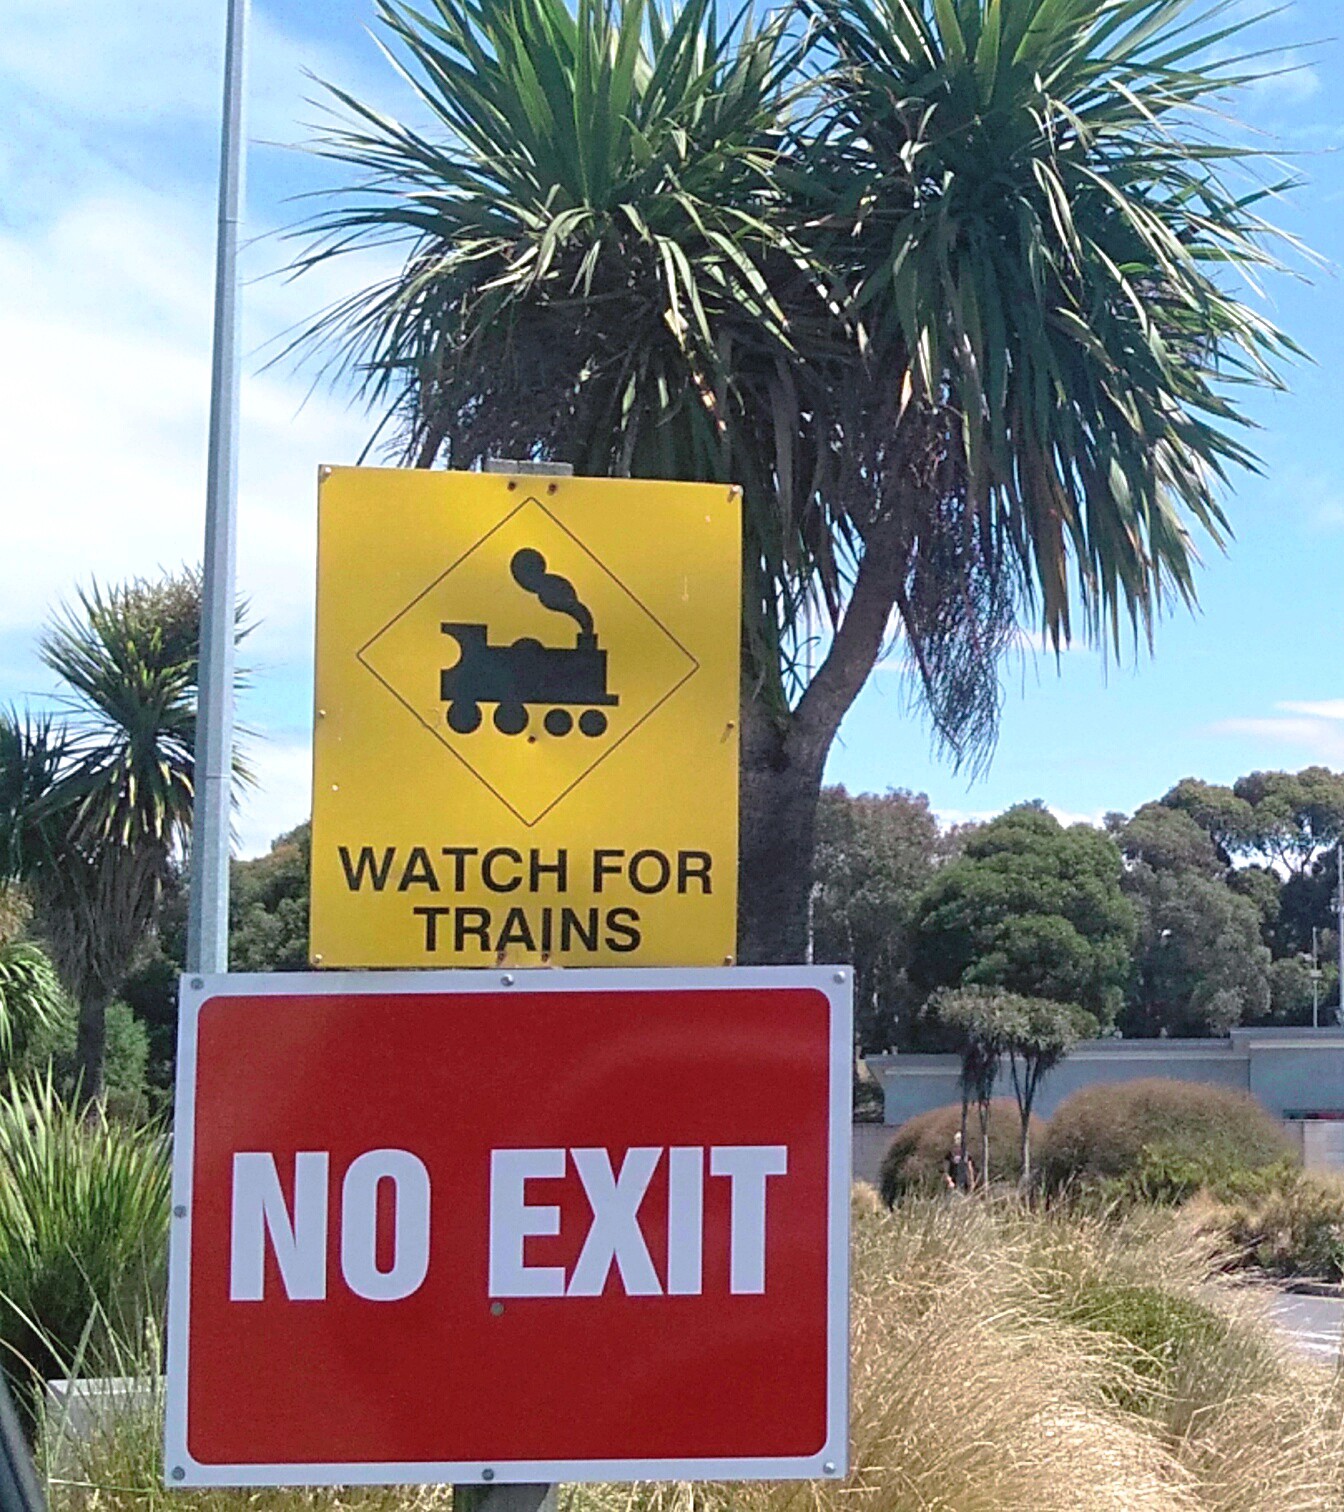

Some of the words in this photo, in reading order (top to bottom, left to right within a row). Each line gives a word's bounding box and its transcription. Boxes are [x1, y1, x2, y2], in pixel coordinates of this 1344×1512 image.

[338, 846, 567, 893] WATCH
[592, 849, 713, 894] FOR
[413, 907, 642, 952] TRAINS
[230, 1148, 431, 1302] NO
[488, 1145, 788, 1298] EXIT
